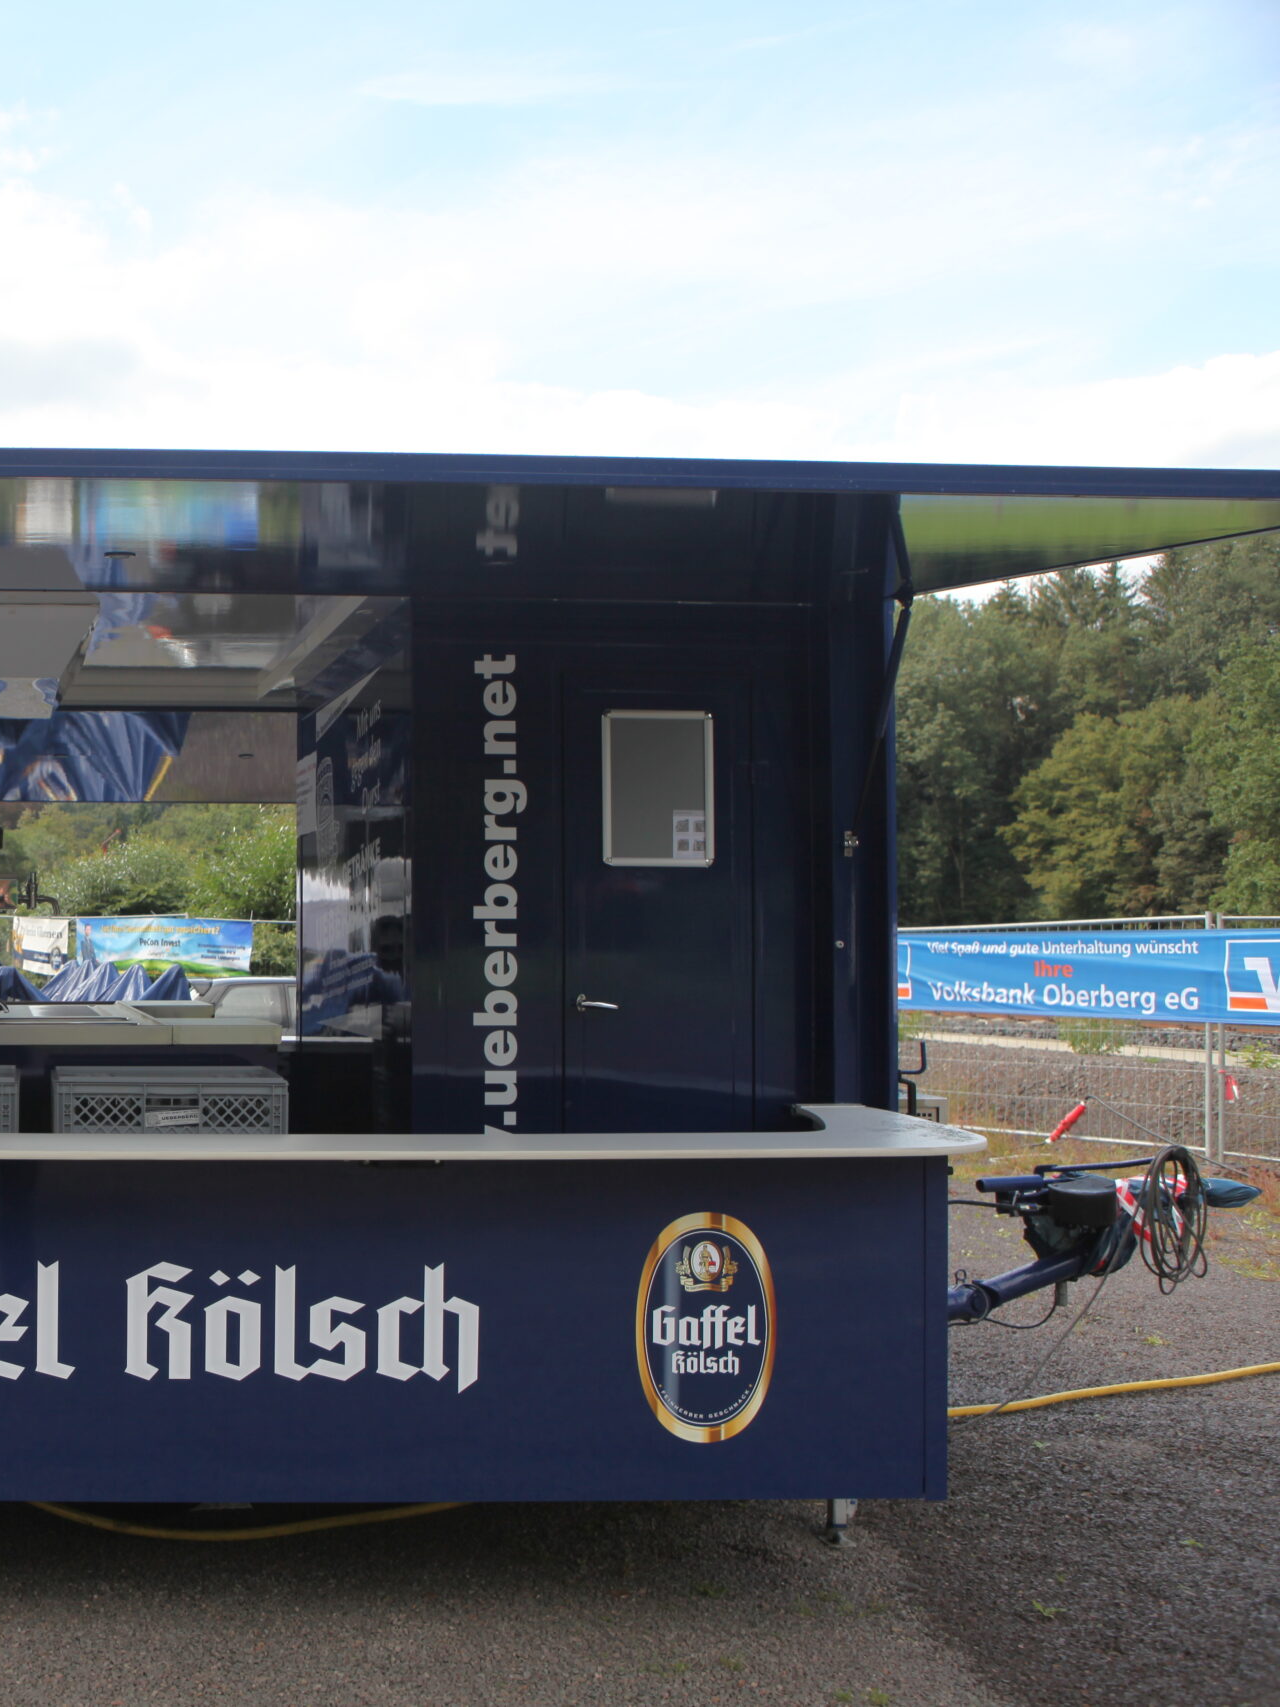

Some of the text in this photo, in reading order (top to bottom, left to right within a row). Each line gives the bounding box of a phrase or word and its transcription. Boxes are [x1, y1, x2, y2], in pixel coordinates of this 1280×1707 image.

[473, 654, 527, 1134] .ueberberg.net
[161, 938, 180, 947] Invest
[928, 940, 1199, 958] Viel Spaß und gute Unterhaltung wünscht
[1033, 960, 1073, 978] Ihre
[928, 981, 1199, 1014] Volksbank Oberberg eG
[124, 1260, 480, 1394] Kölsch
[652, 1304, 761, 1350] Gaffel
[671, 1350, 740, 1376] Kölsch
[708, 1389, 750, 1419] GESCHMACK
